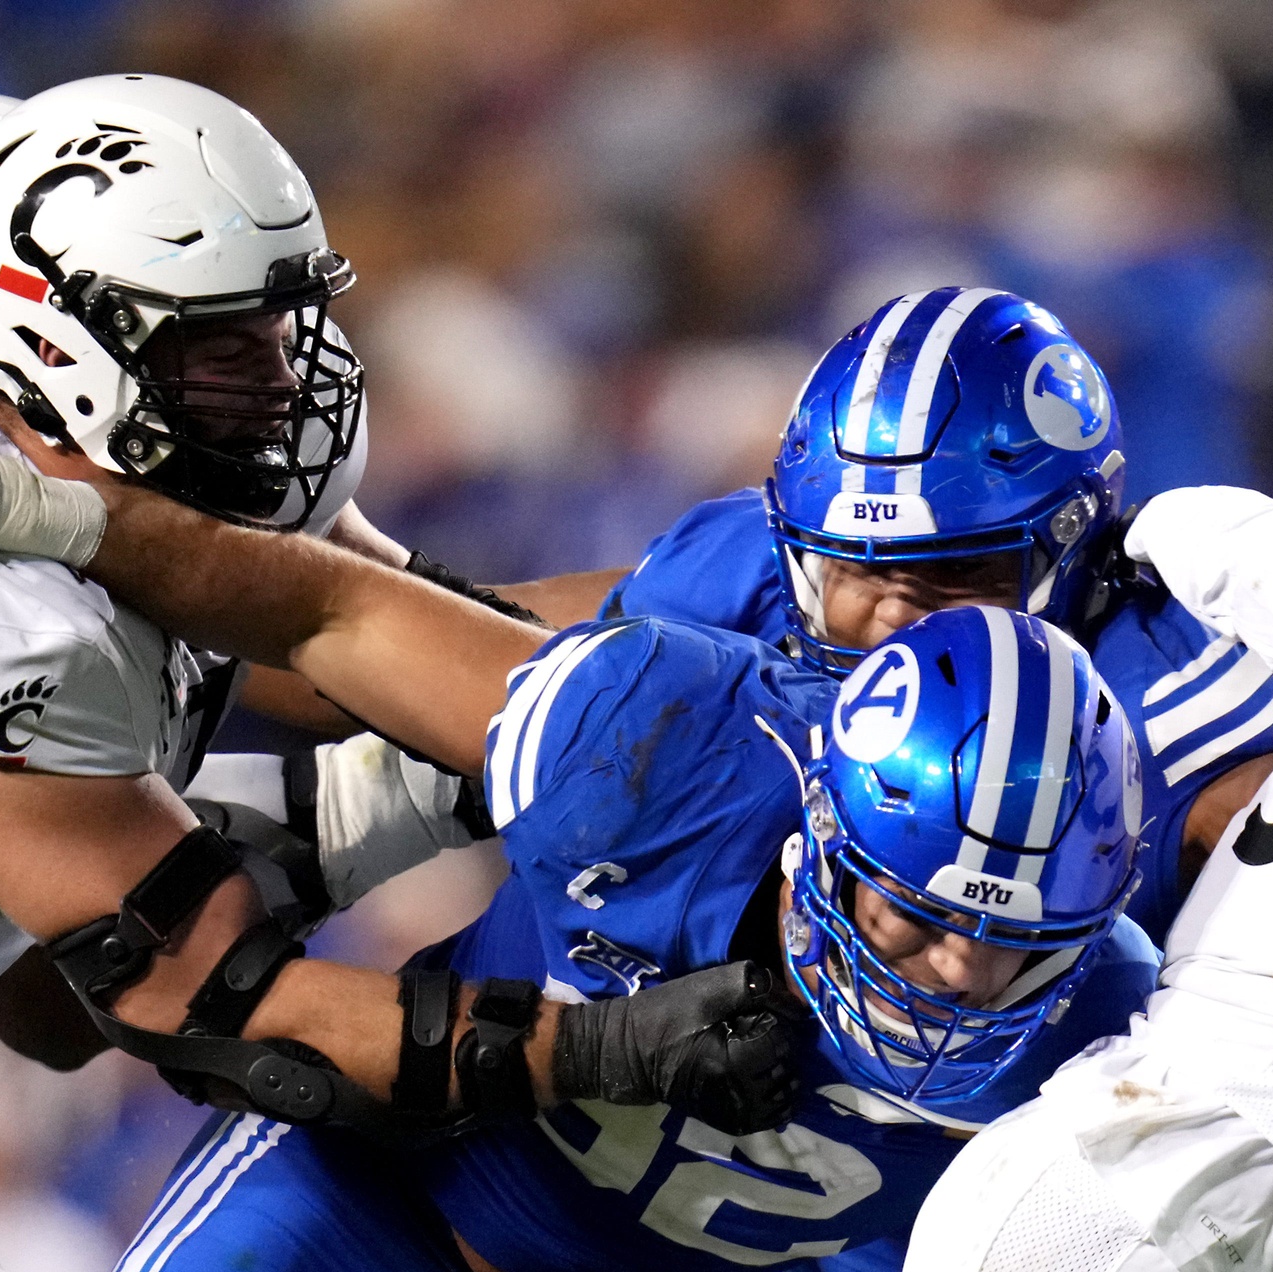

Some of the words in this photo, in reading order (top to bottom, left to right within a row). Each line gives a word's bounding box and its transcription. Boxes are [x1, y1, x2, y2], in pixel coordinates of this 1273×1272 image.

[853, 500, 898, 522] BYU
[839, 649, 908, 733] Y
[567, 862, 627, 910] C
[961, 881, 1014, 907] BYU
[1200, 1215, 1244, 1265] DRI-FIT
